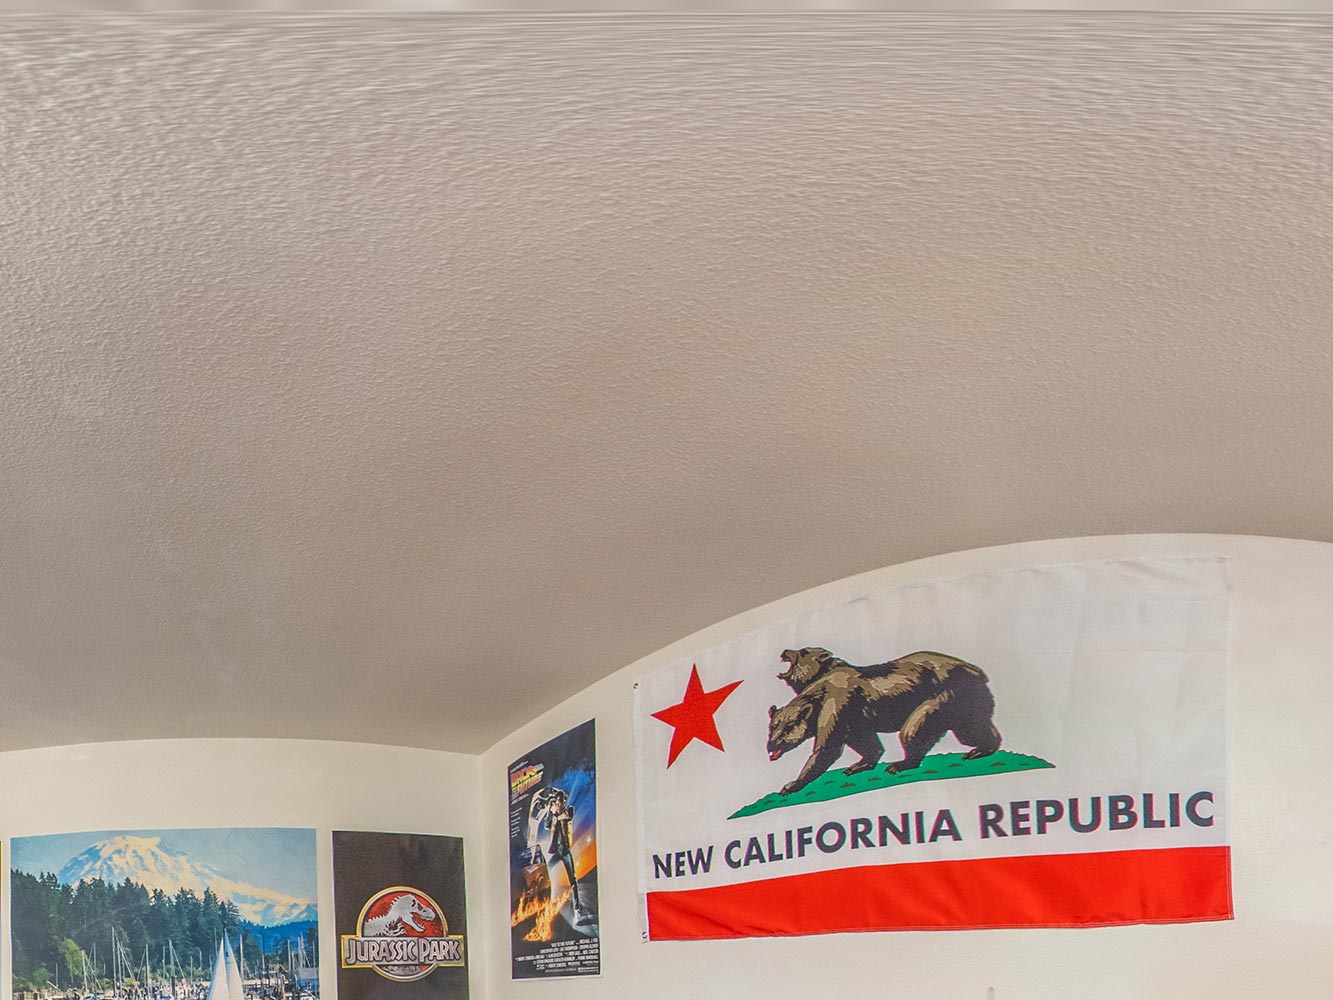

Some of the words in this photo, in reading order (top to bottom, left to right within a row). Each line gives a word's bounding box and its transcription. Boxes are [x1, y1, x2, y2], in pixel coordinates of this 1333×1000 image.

[652, 845, 714, 879] NEW
[724, 809, 962, 869] CALIFORNIA
[978, 791, 1215, 839] REPUBLIC
[346, 938, 417, 965] JURASSIC
[418, 938, 461, 963] PARK
